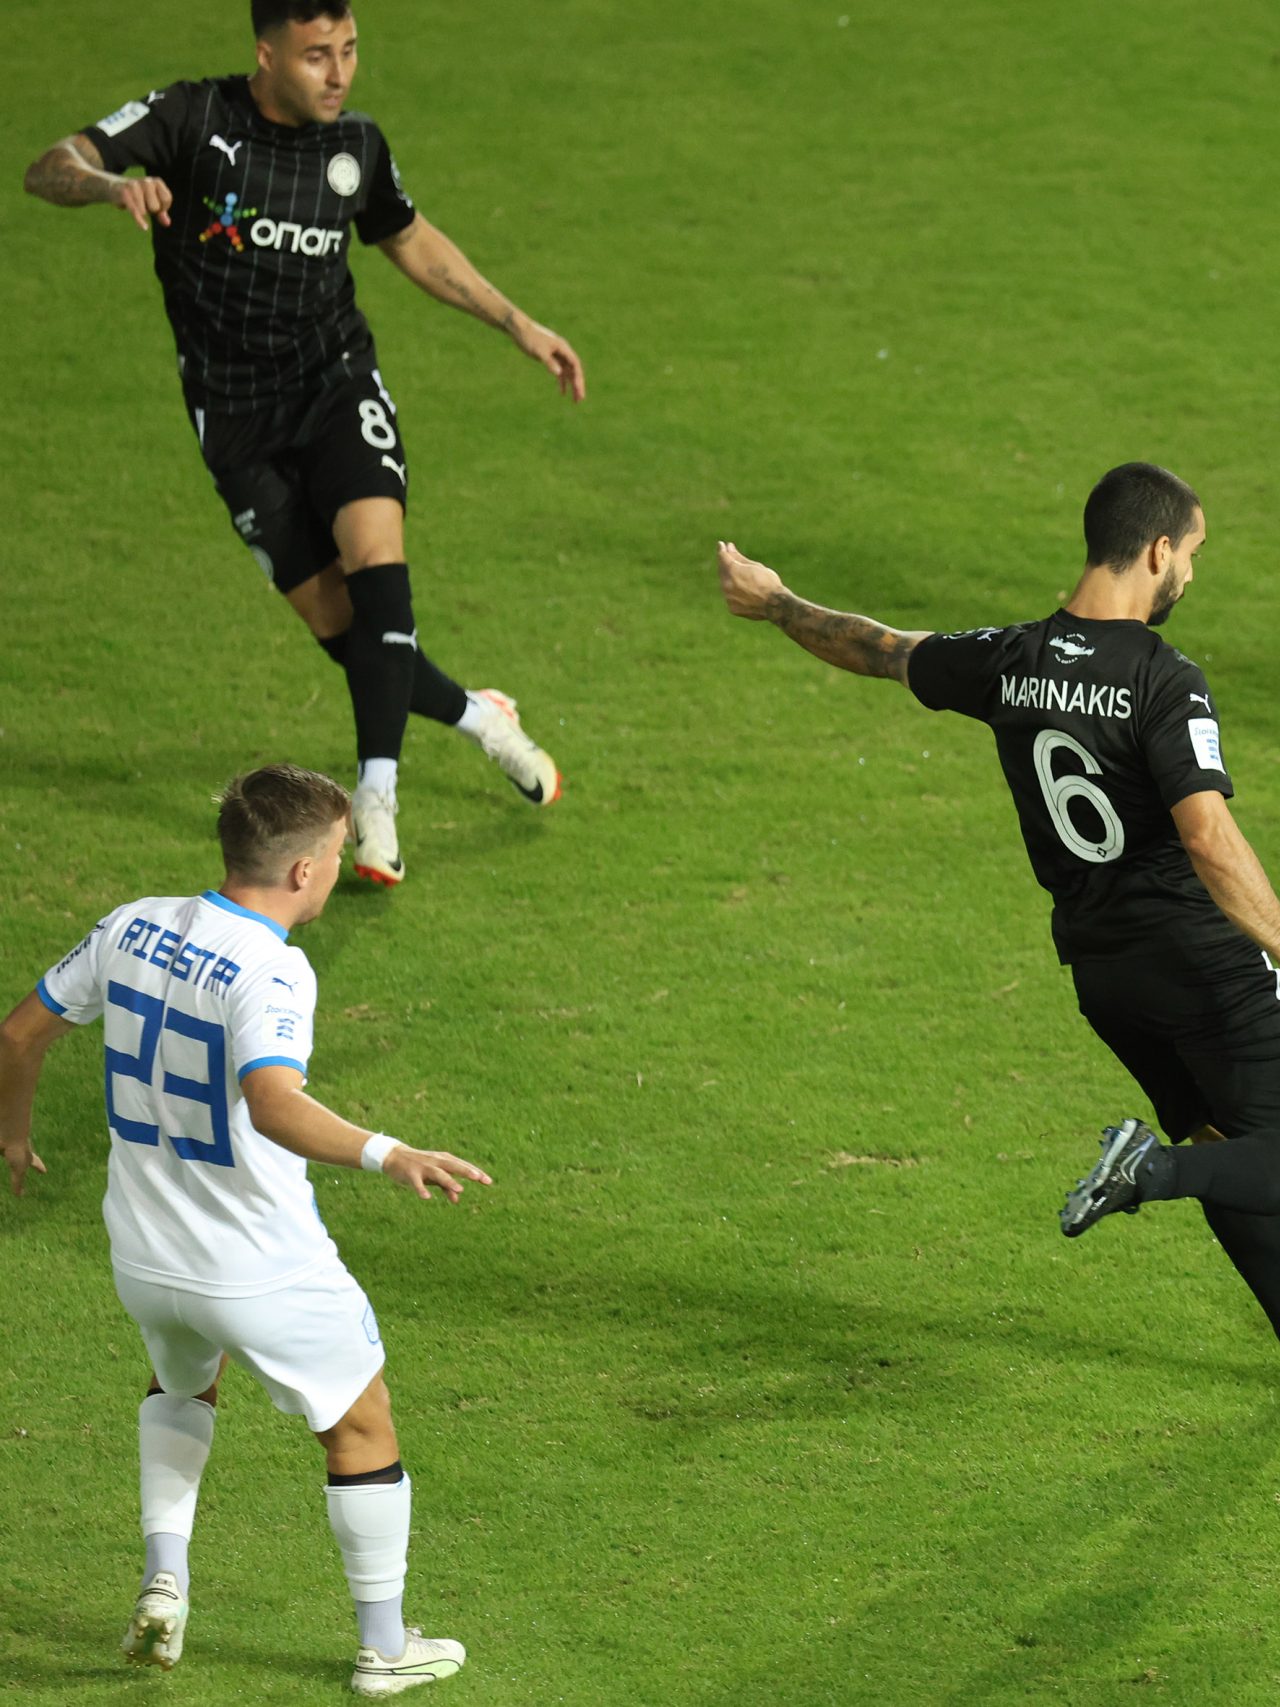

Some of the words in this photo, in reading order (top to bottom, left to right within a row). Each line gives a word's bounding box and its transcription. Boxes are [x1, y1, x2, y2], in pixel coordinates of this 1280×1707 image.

[358, 399, 396, 450] 8
[1000, 674, 1132, 719] MARINAKIS
[1033, 729, 1125, 863] 6
[104, 980, 236, 1168] 23
